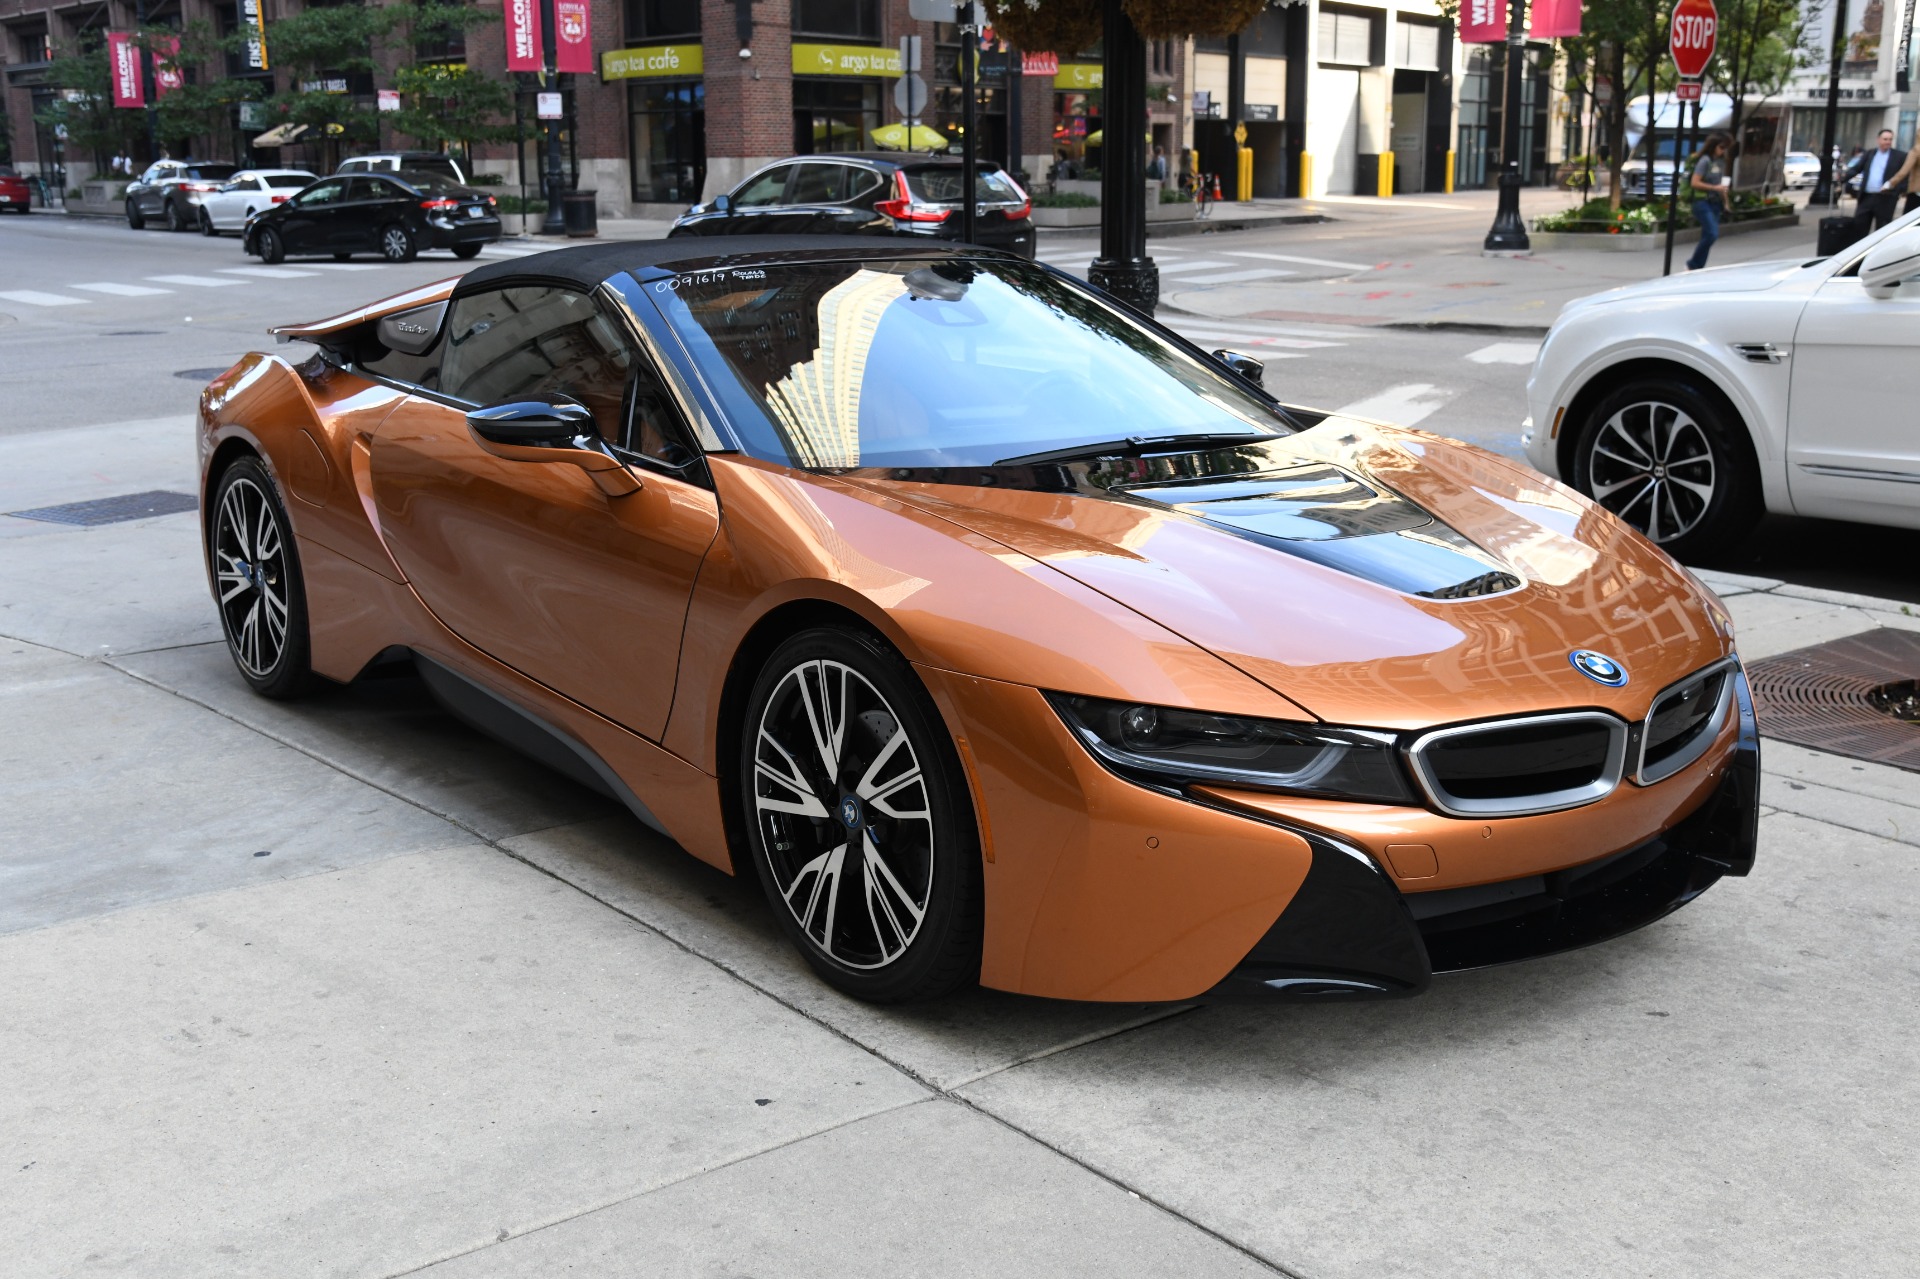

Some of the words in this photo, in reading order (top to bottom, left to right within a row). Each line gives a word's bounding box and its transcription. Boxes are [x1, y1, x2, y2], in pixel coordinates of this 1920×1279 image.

[1487, 0, 1495, 26] WATE
[246, 16, 262, 68] EINSEN
[512, 0, 528, 58] WELCO
[1673, 15, 1714, 49] STOP
[116, 42, 131, 98] WELCOME
[648, 47, 680, 70] café
[840, 54, 868, 74] argo
[870, 54, 885, 70] tea
[655, 272, 725, 293] 0091619
